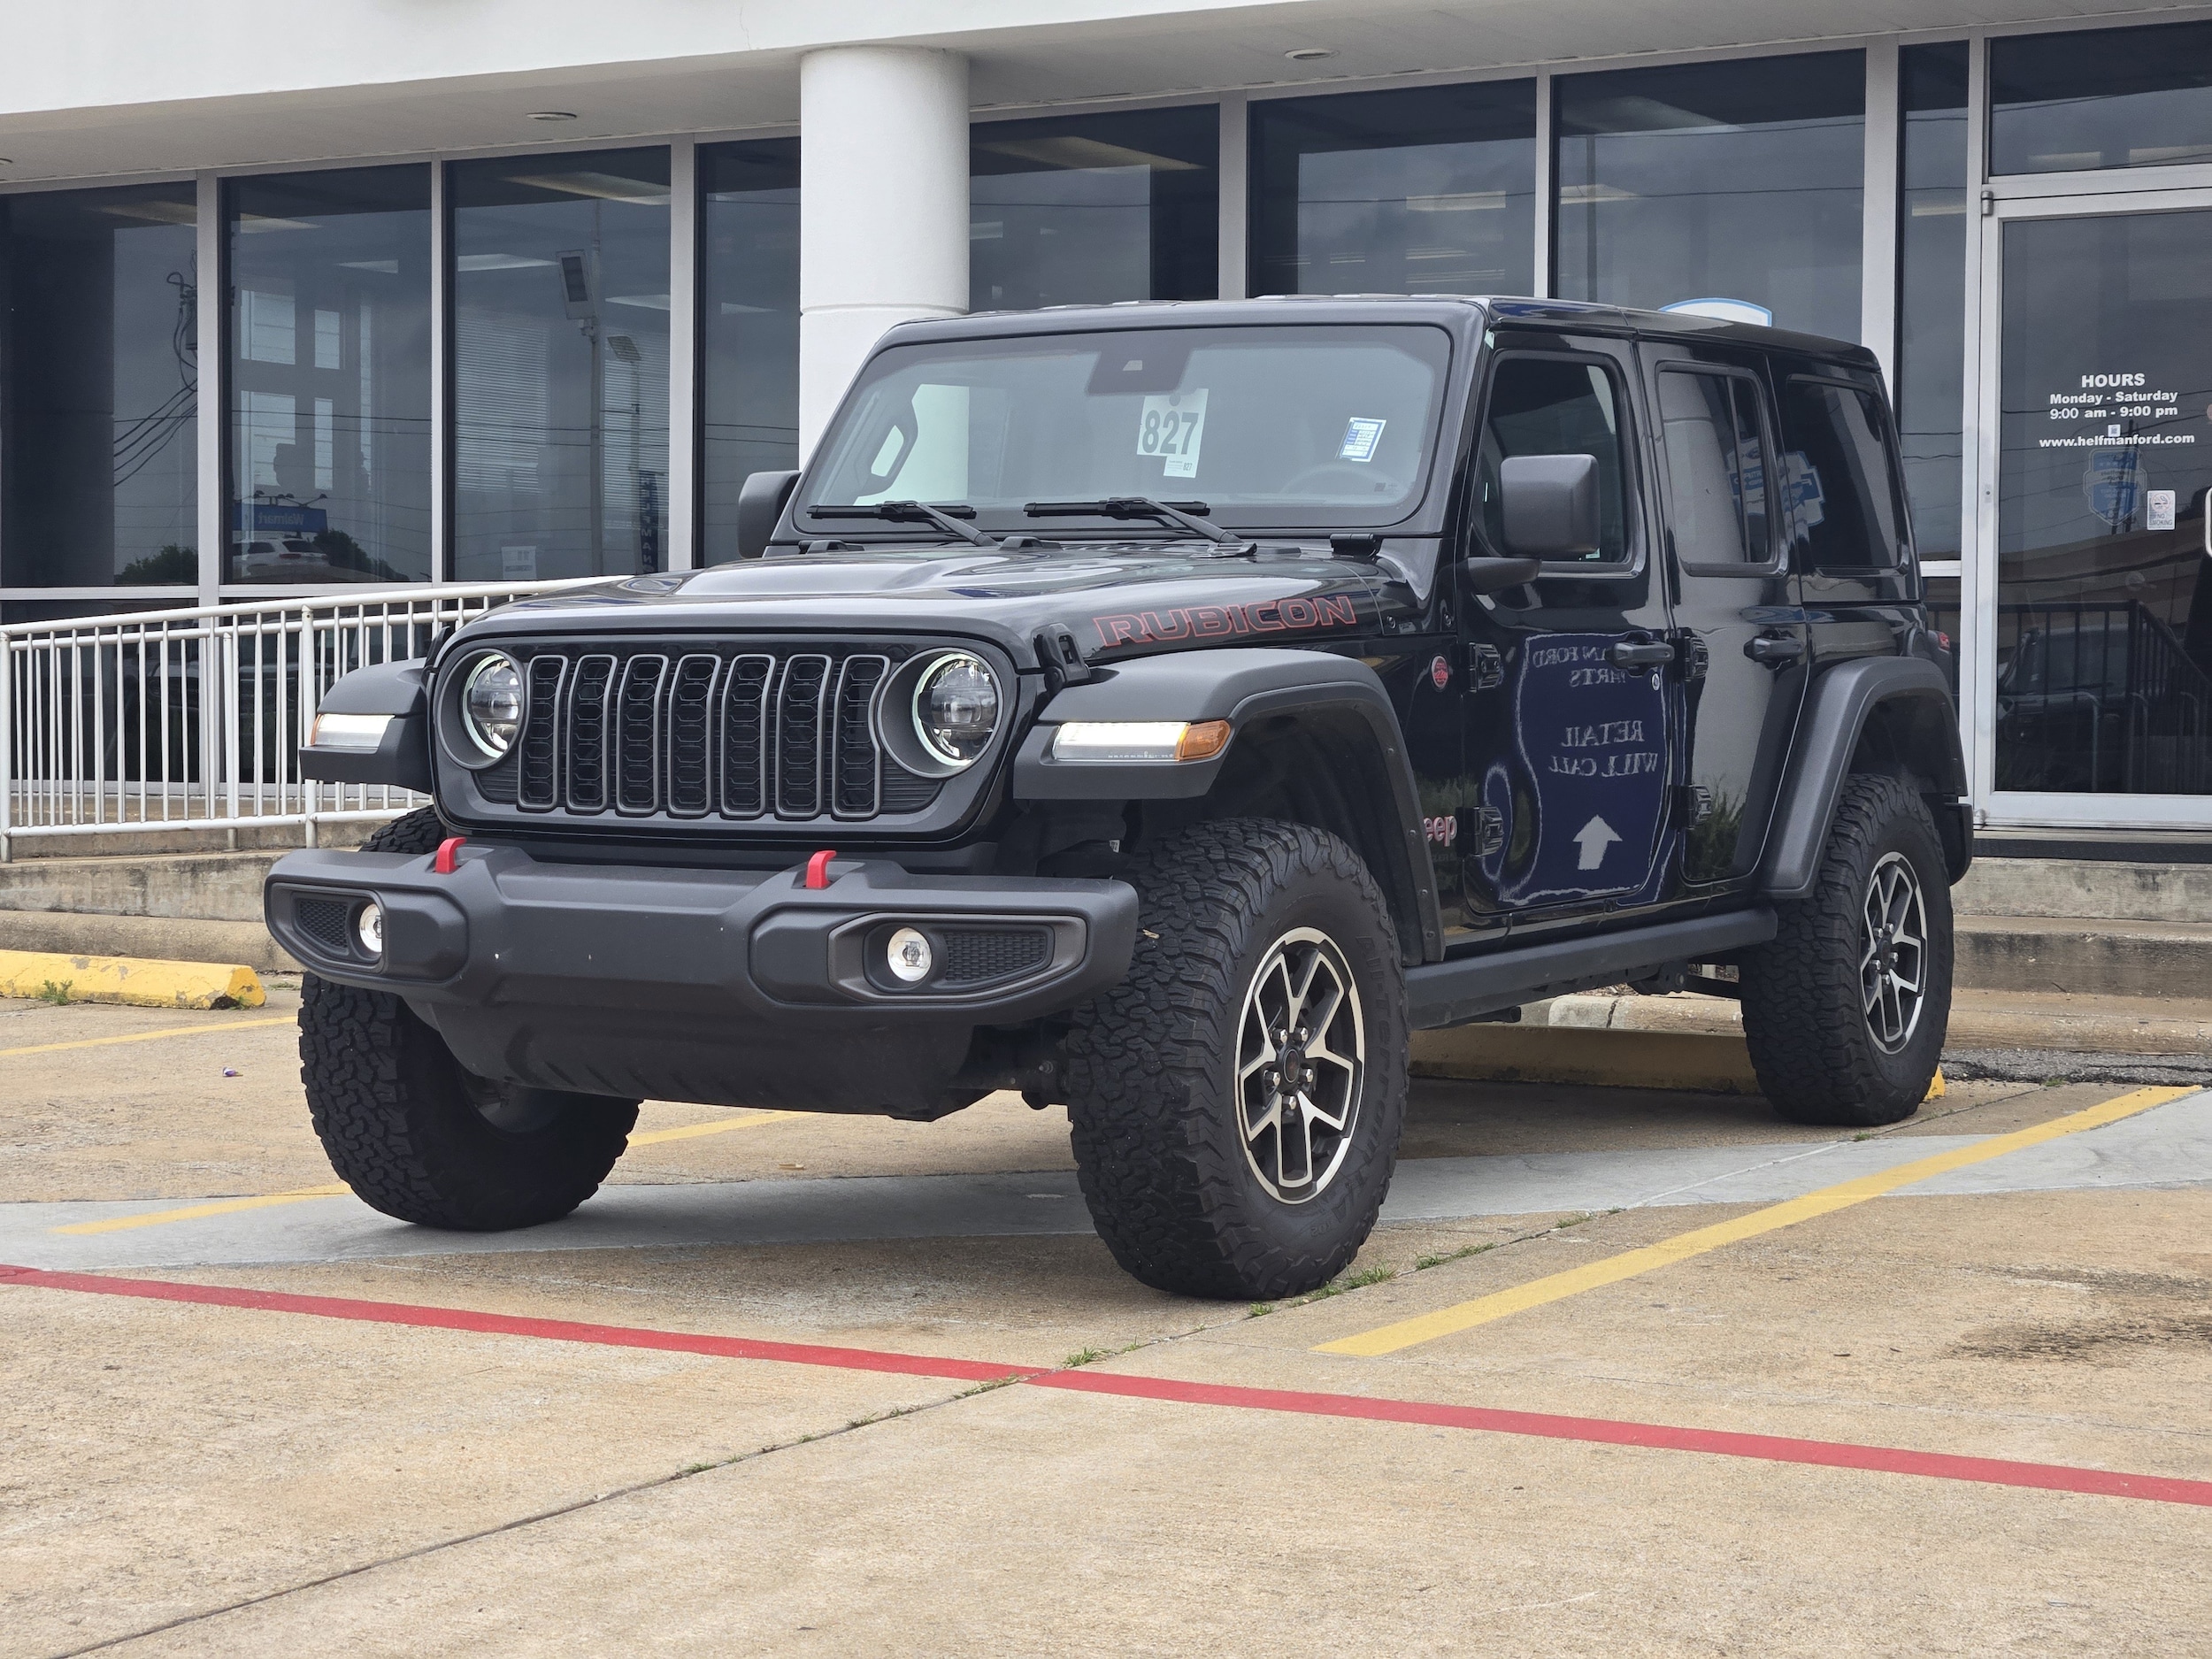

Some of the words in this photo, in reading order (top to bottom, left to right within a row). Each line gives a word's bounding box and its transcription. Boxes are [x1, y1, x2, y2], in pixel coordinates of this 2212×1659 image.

[2081, 373, 2145, 388] HOURS
[2050, 393, 2103, 405] Monday
[2116, 390, 2178, 403] Saturday
[2050, 407, 2079, 420] 9:00
[2084, 409, 2107, 418] am
[2120, 405, 2151, 417] 9:00
[2155, 406, 2178, 418] pm
[1141, 410, 1199, 455] 827
[2039, 433, 2195, 448] www.helfmanford.com
[1183, 462, 1193, 472] 827
[1094, 595, 1357, 647] RUBICON
[1424, 815, 1457, 847] eep
